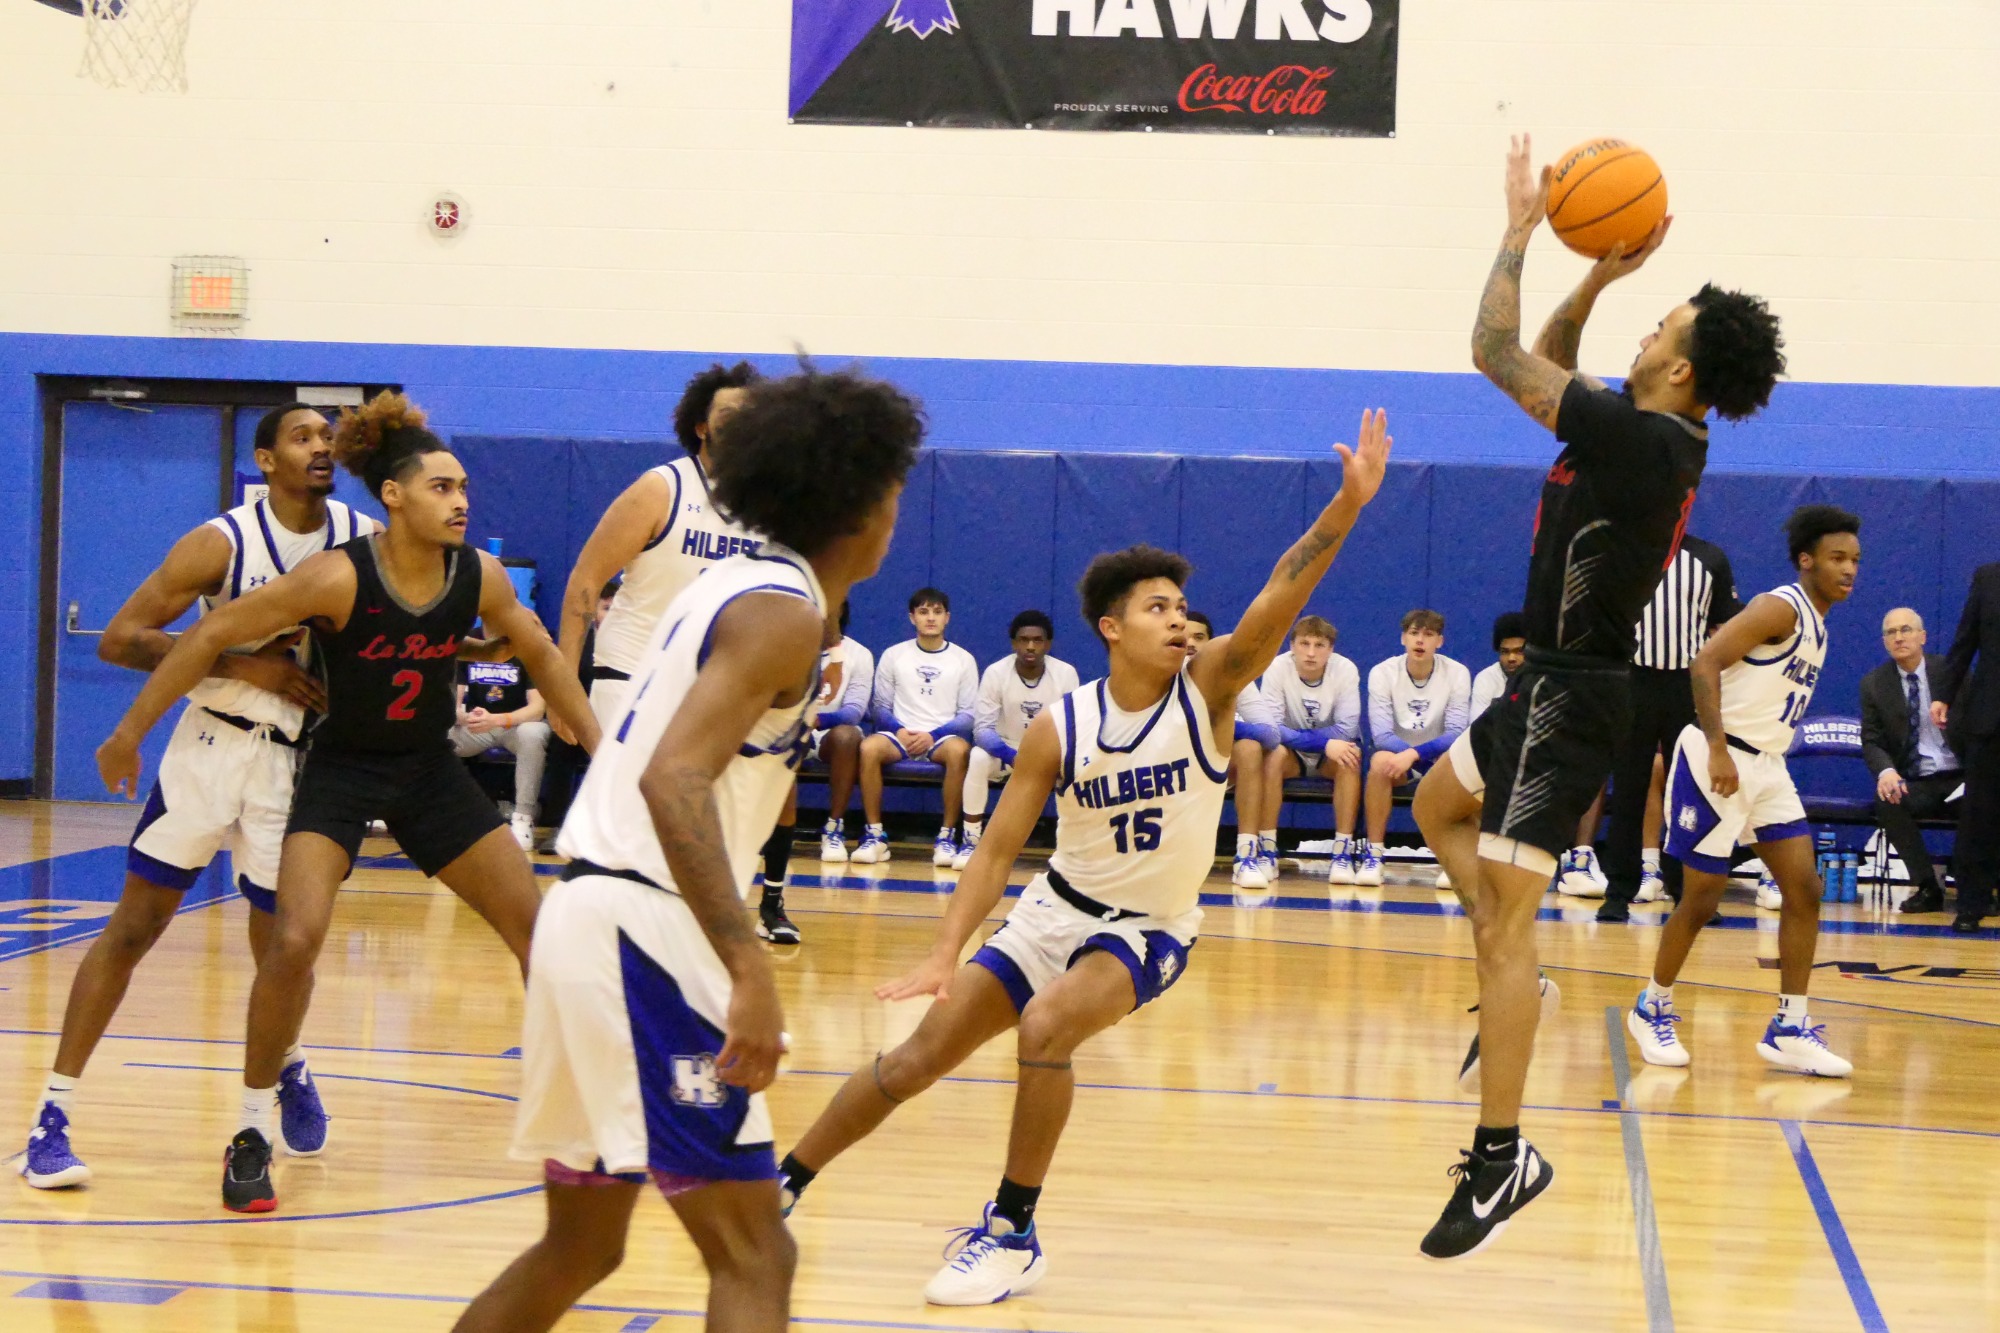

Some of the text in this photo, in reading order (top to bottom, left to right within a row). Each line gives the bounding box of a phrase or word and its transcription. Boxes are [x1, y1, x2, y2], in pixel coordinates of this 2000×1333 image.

[1053, 63, 1337, 115] PROUDLY SERVING Coca-Cola
[358, 633, 458, 660] La Roch
[386, 669, 424, 721] 2
[1778, 691, 1807, 729] 10
[1073, 757, 1189, 810] HILBERT
[1109, 807, 1163, 854] 15
